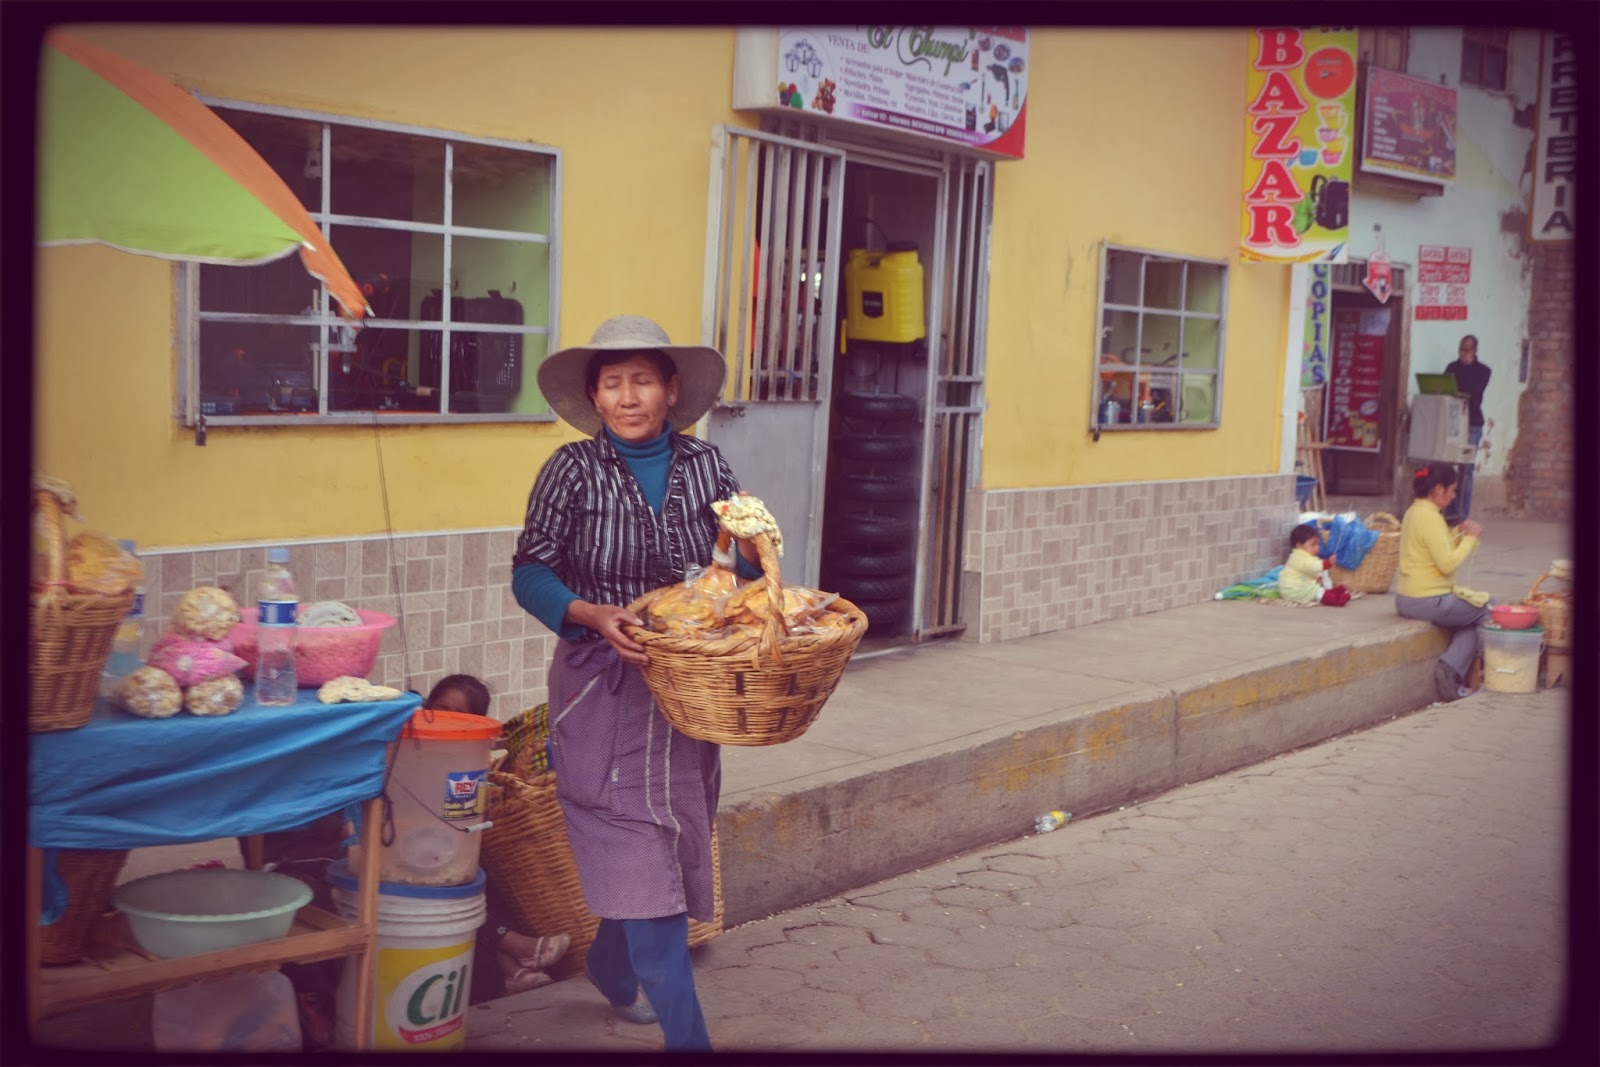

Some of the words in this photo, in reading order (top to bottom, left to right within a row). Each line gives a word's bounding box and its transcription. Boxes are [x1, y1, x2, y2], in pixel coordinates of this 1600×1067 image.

[827, 34, 855, 52] VENTA
[1246, 27, 1307, 246] BAZAR
[1310, 264, 1328, 384] COPIAS
[455, 781, 476, 793] REY
[407, 965, 467, 1026] Cil
